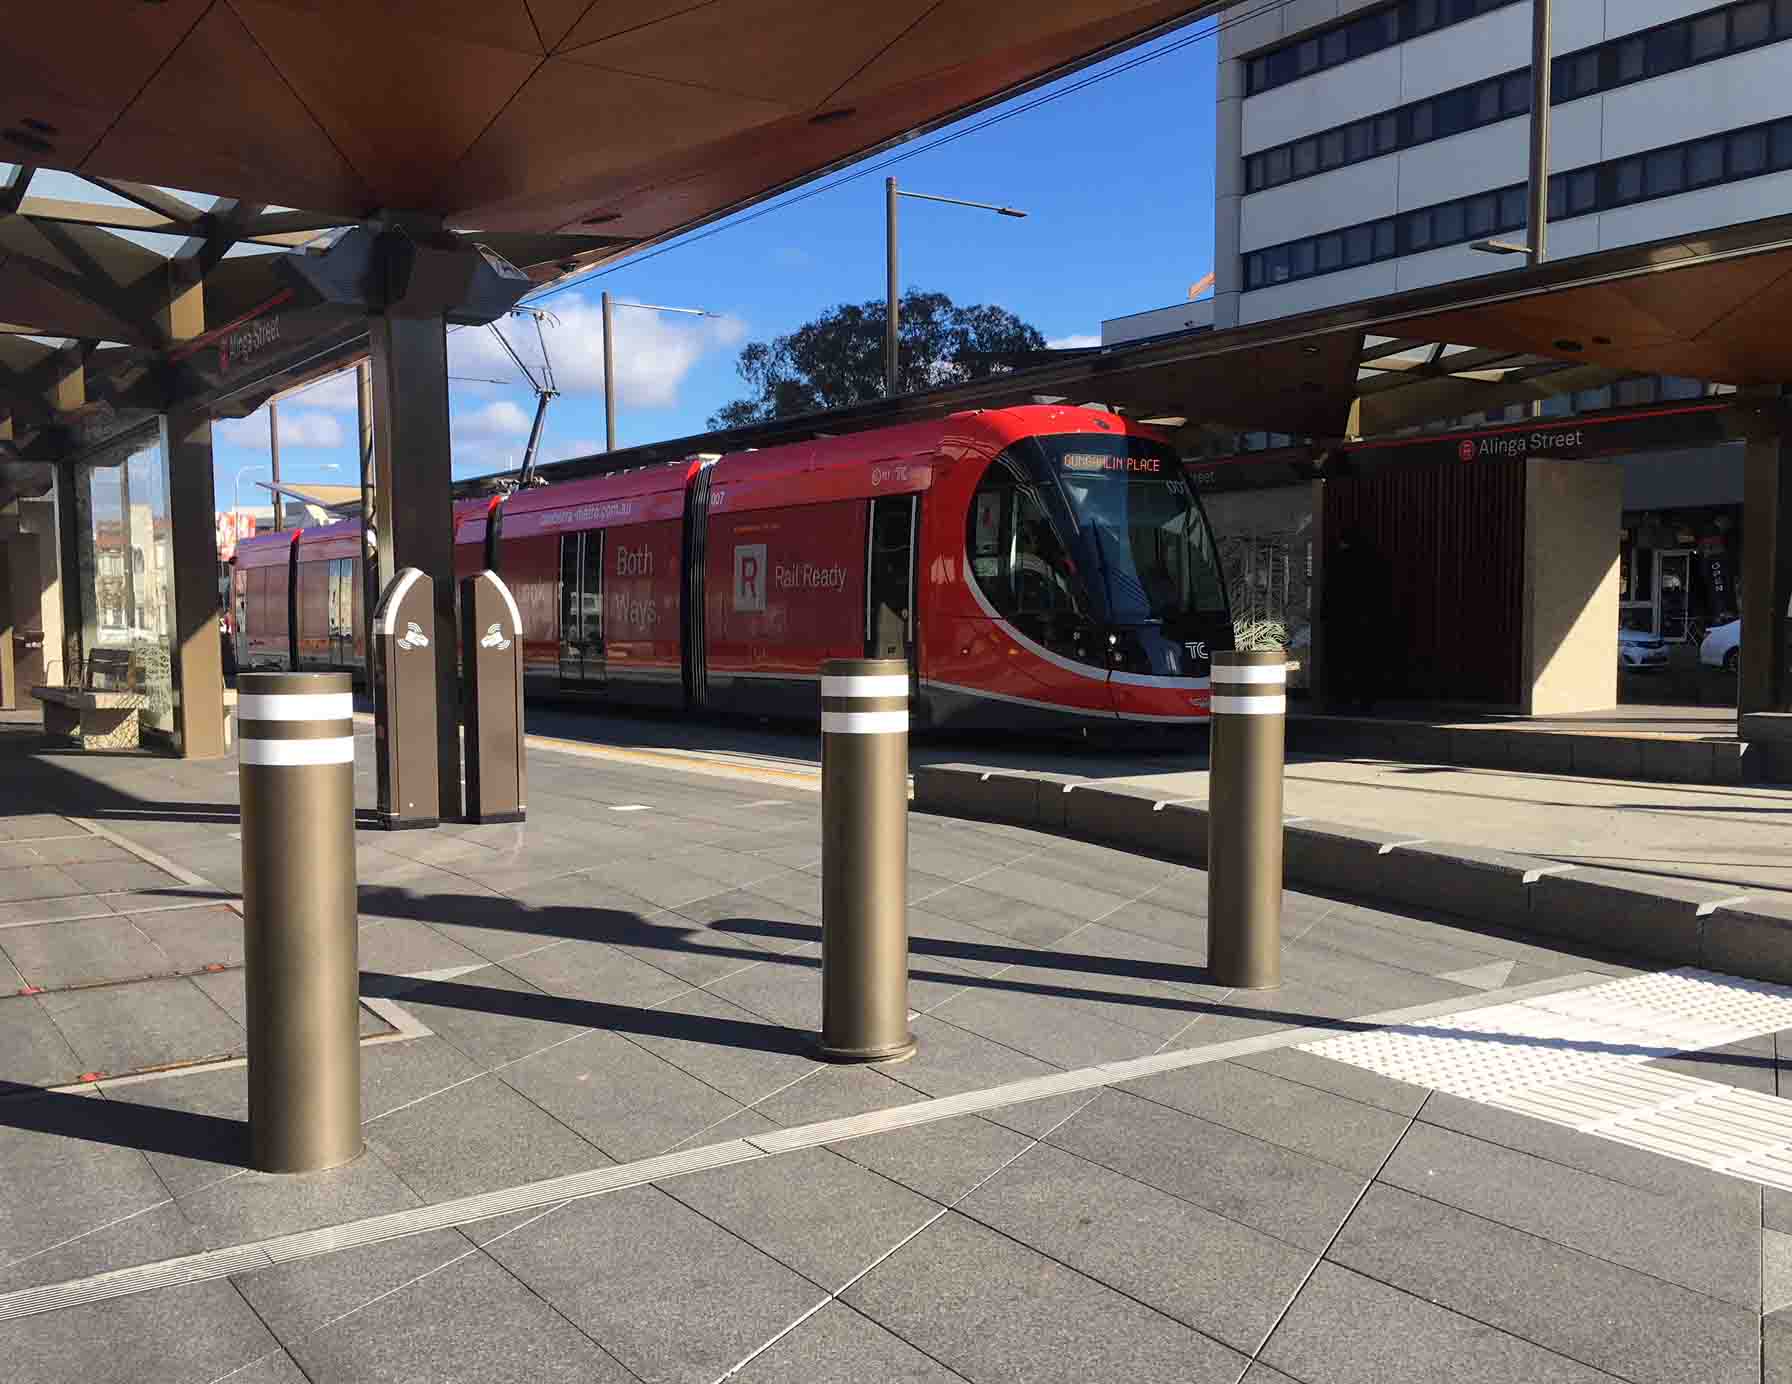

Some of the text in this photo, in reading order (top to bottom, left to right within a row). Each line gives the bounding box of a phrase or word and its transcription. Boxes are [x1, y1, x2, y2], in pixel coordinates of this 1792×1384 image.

[1479, 431, 1584, 457] Alinga Street
[1126, 457, 1161, 472] PLACE
[616, 544, 654, 576] Both
[741, 557, 759, 598] R
[775, 562, 848, 593] Rail Ready
